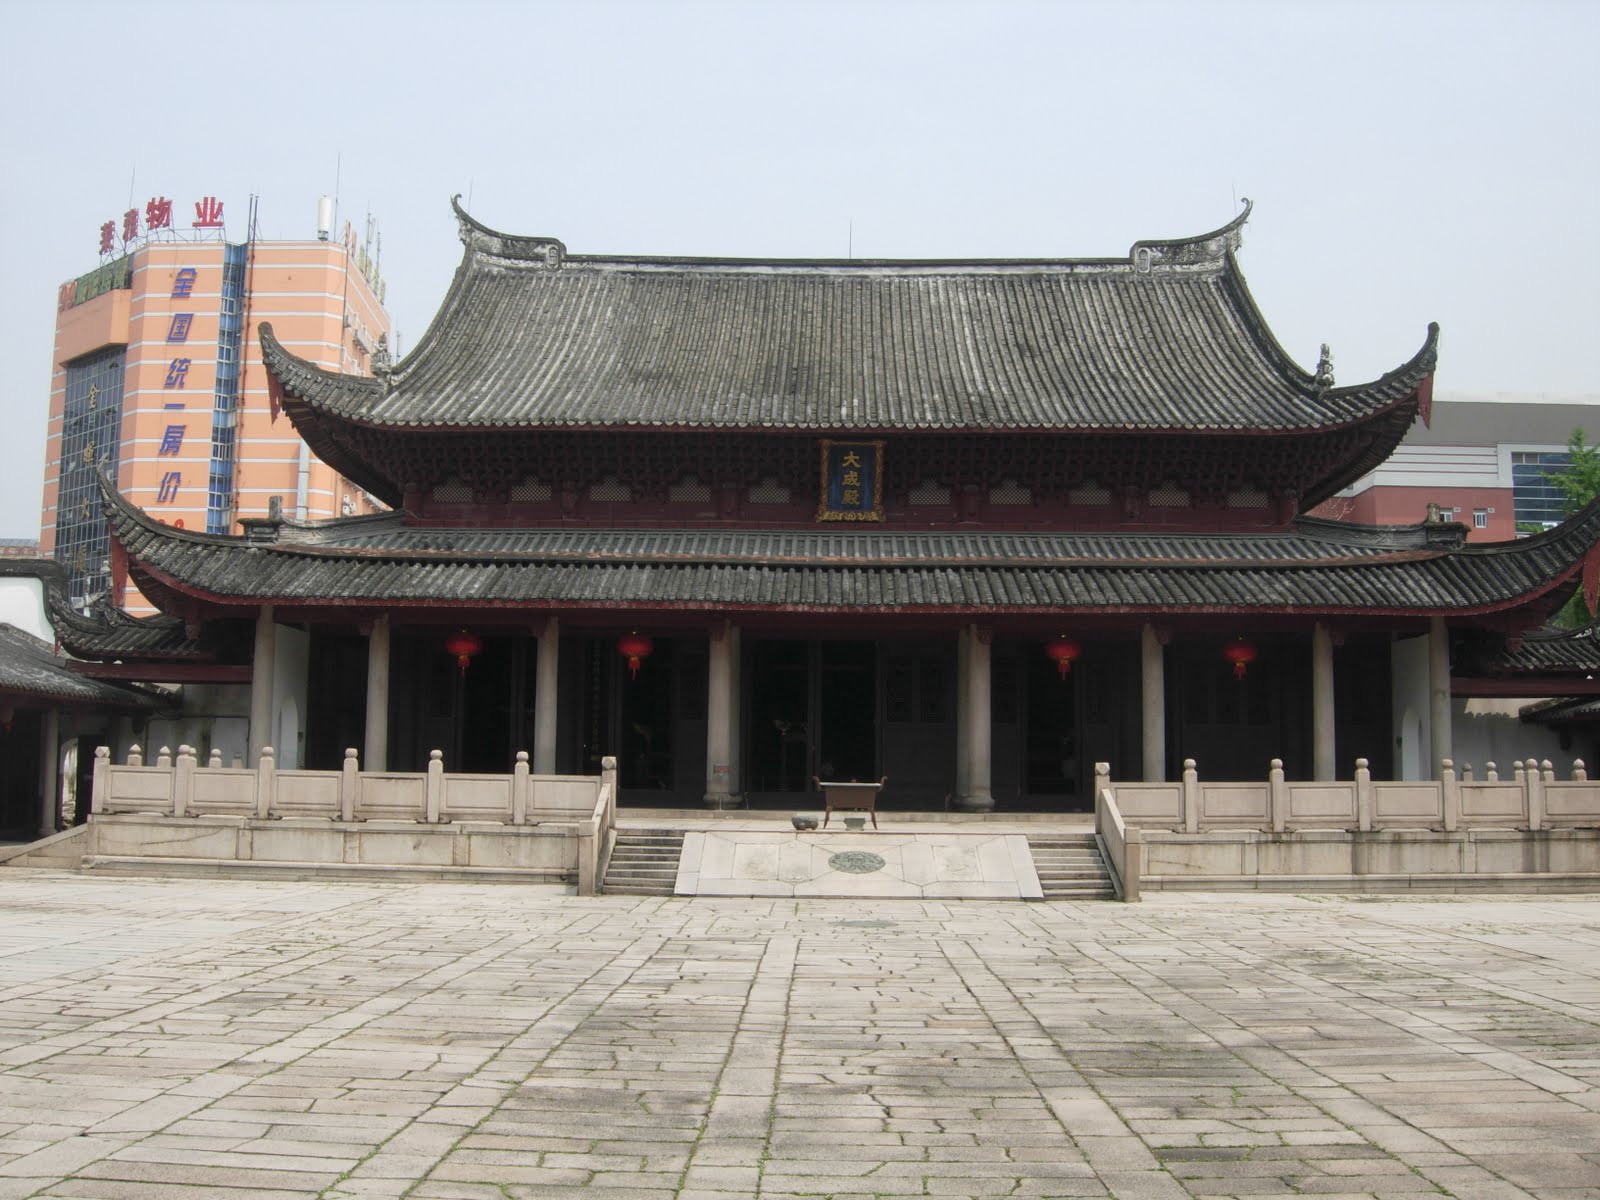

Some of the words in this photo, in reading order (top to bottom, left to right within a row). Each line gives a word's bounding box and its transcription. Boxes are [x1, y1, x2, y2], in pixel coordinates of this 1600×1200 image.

[156, 267, 198, 504] 全国统一房价
[841, 450, 862, 506] 大成殿
